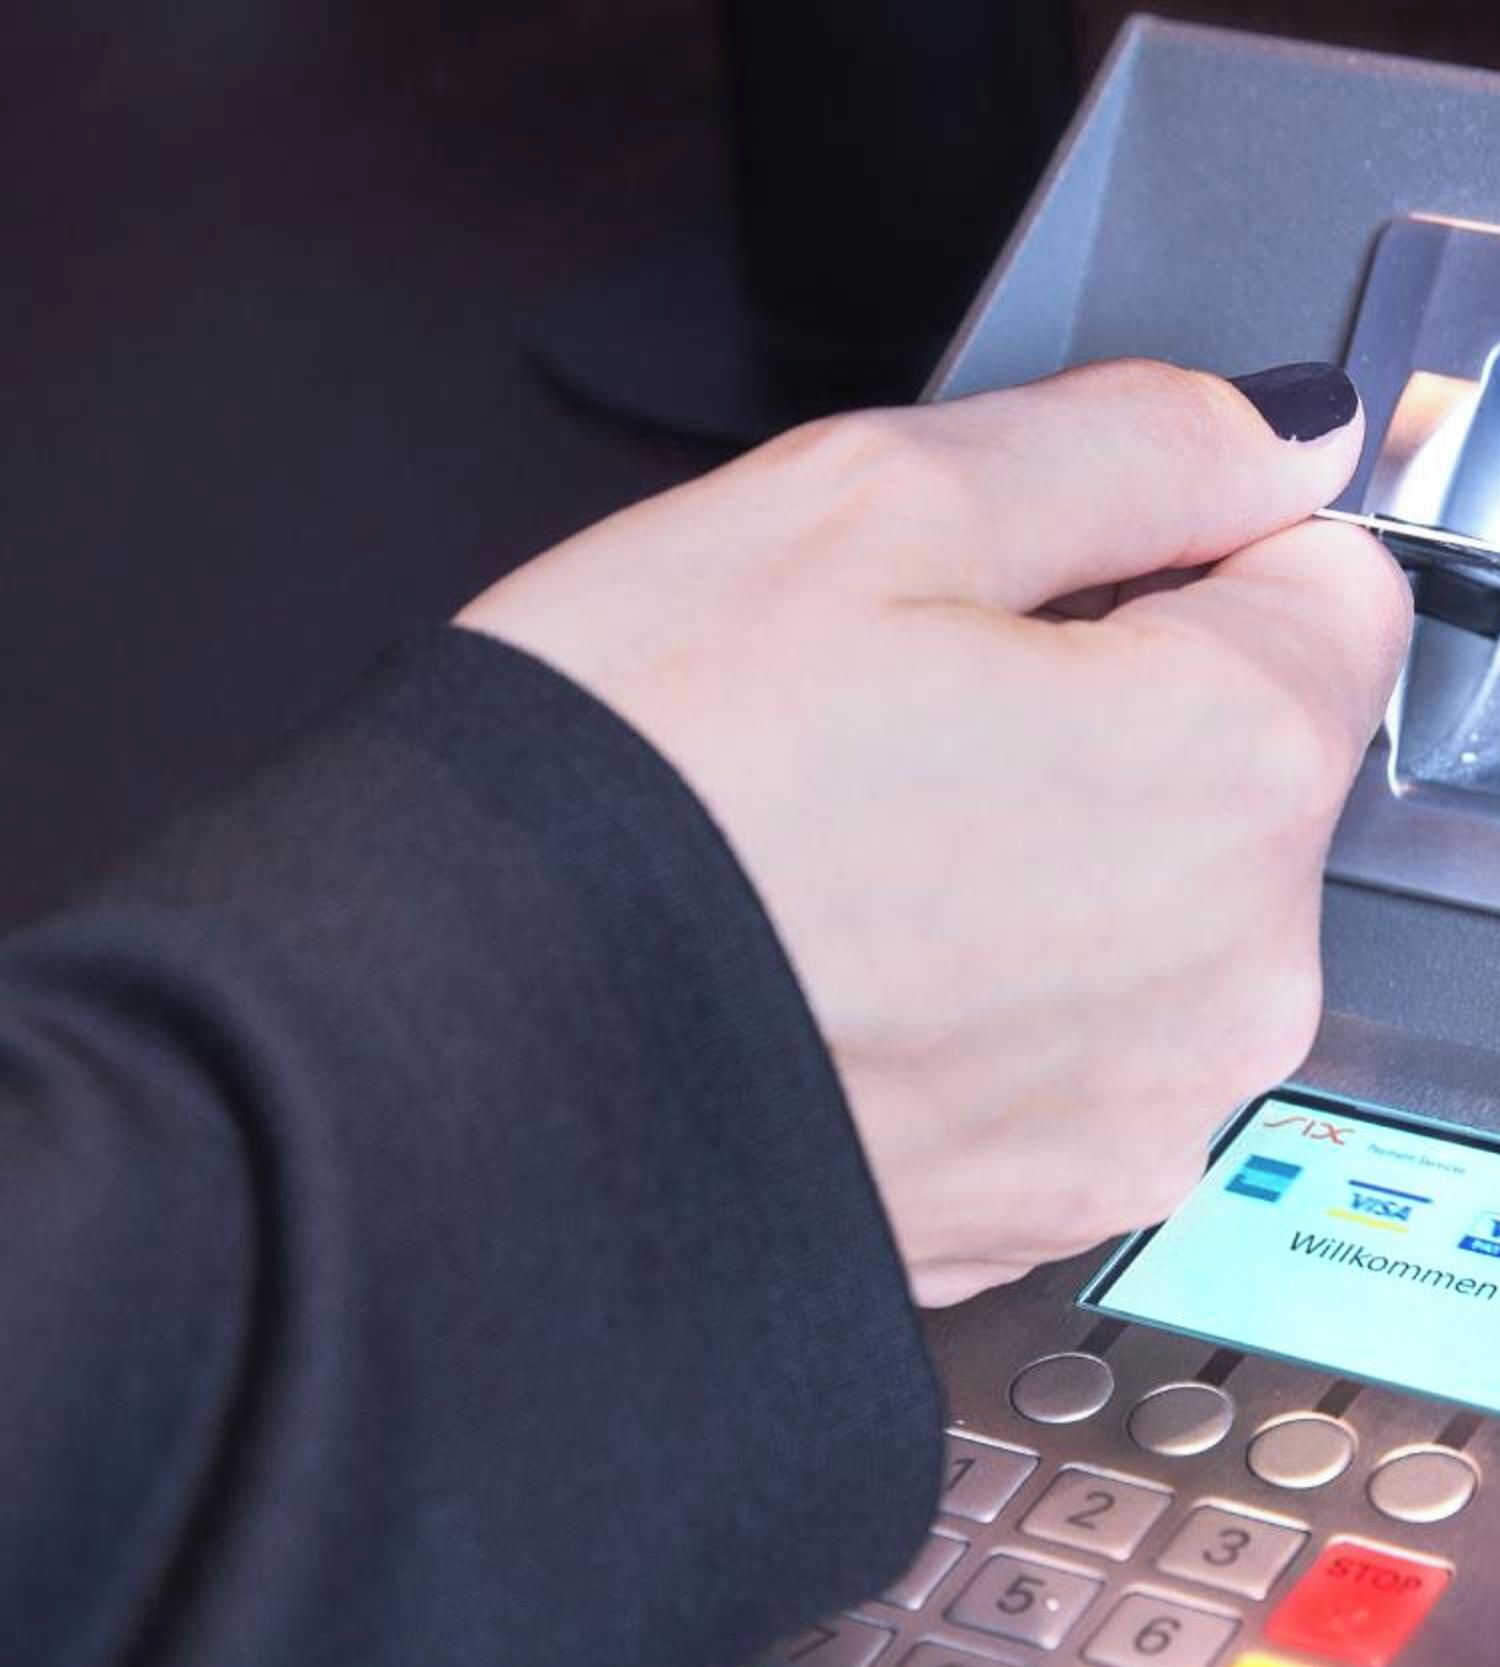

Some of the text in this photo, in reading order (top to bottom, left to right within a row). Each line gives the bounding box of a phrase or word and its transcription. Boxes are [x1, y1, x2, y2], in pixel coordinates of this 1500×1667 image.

[1350, 1193, 1412, 1222] VISA
[1289, 1231, 1498, 1300] Willkommen
[1067, 1491, 1115, 1529] 2
[1203, 1529, 1249, 1567] 3
[1326, 1556, 1423, 1594] STOP
[996, 1575, 1046, 1614] 5
[1134, 1617, 1180, 1655] 6
